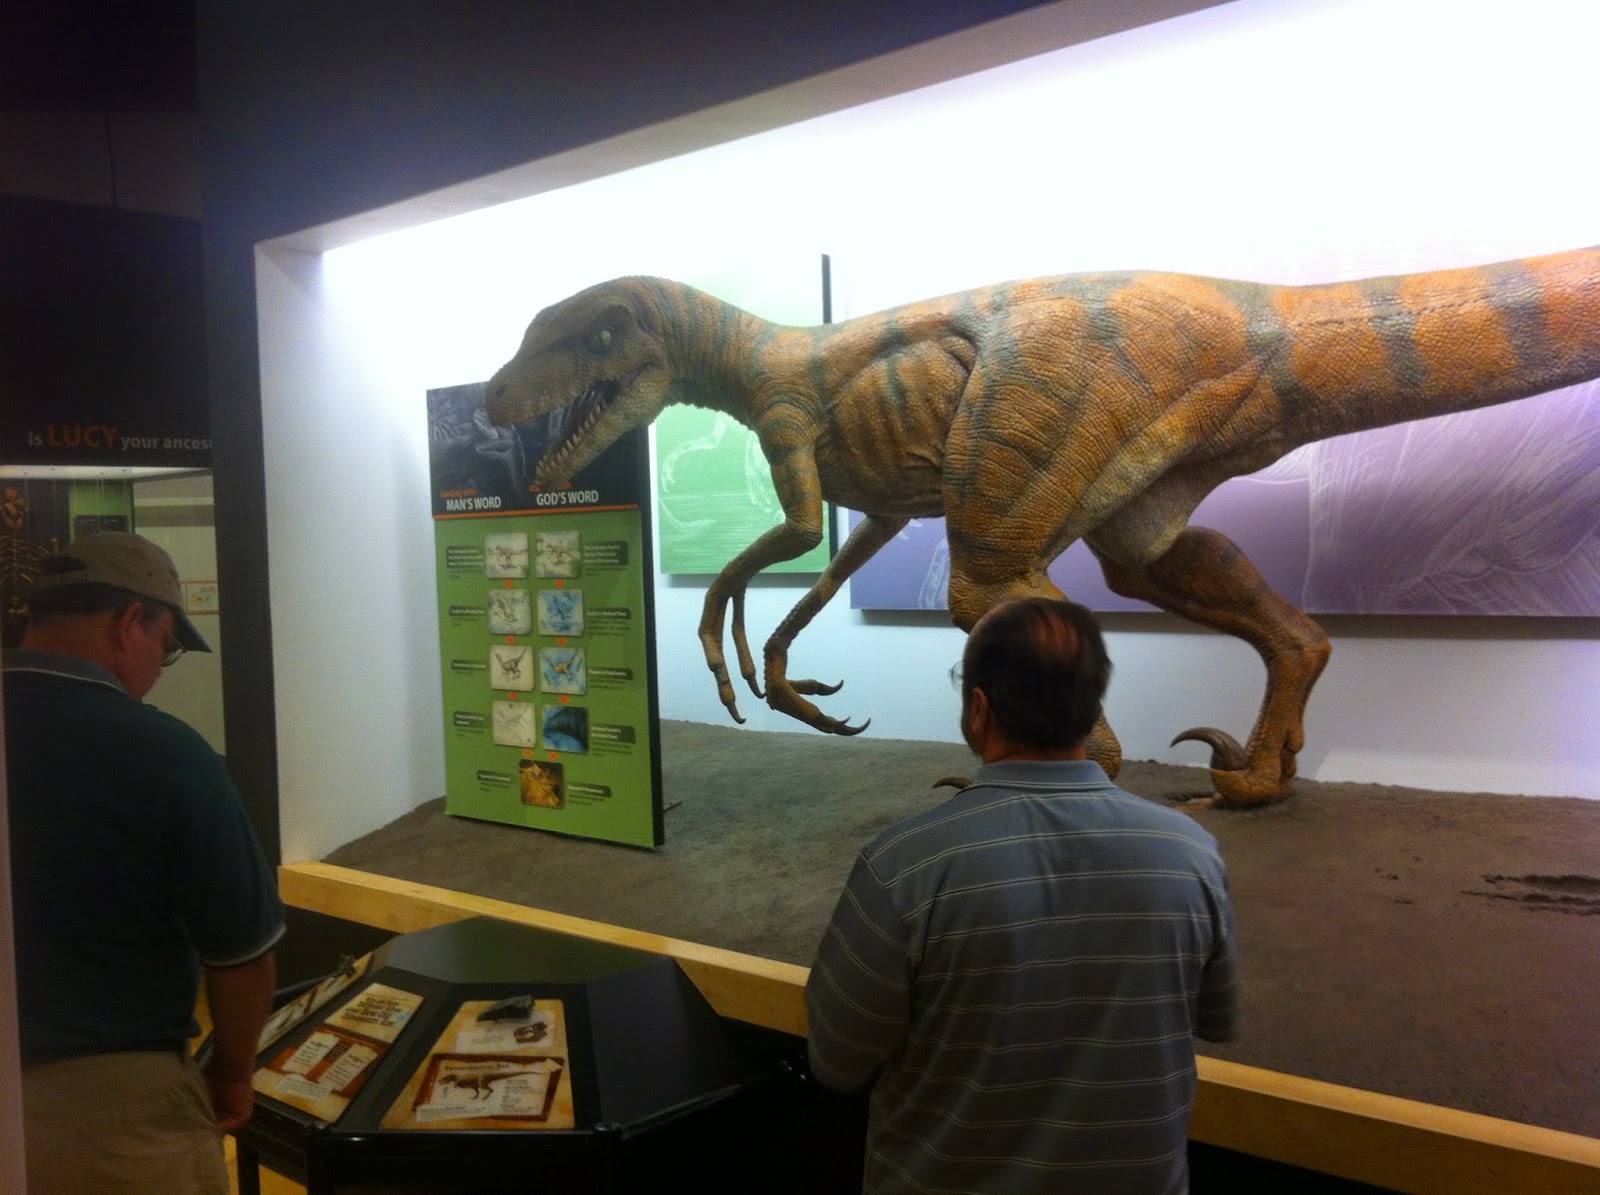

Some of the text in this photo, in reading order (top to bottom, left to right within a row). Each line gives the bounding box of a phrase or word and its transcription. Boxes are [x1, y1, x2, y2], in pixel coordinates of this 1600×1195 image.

[28, 431, 42, 446] Is
[48, 425, 118, 447] LUCY
[121, 437, 158, 450] your
[446, 496, 501, 511] MAN'S WORD
[536, 490, 599, 506] GOD'S WORD
